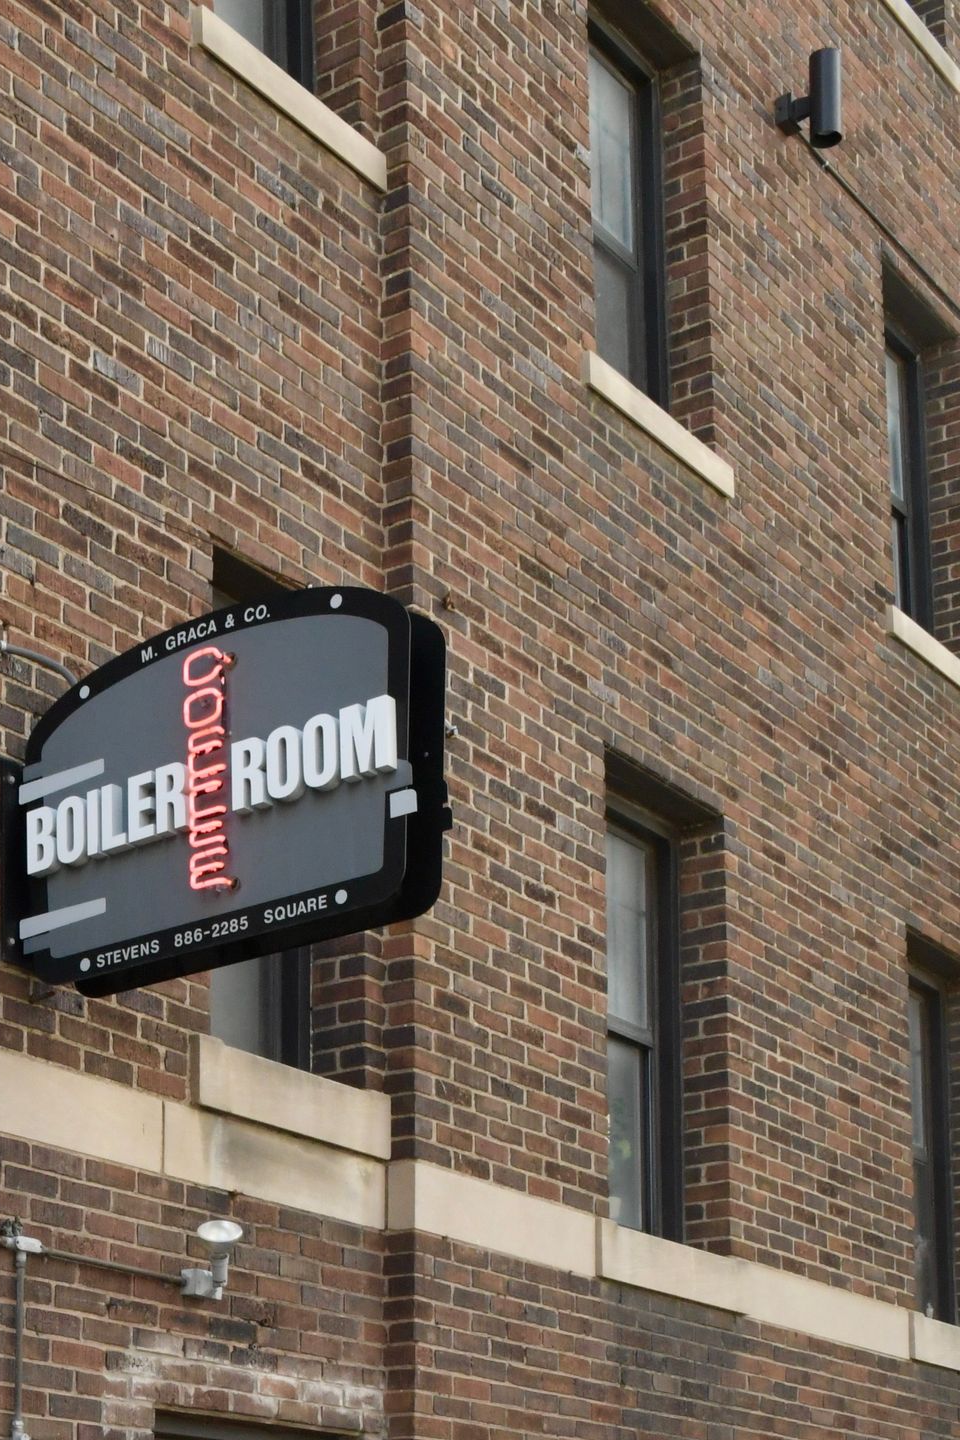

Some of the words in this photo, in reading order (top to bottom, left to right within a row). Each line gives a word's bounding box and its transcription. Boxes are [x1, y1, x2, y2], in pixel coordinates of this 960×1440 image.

[141, 646, 158, 663] M.
[165, 619, 217, 651] GRACA
[224, 613, 235, 629] &
[243, 604, 271, 623] CO.
[26, 761, 191, 877] BOILER
[230, 693, 398, 816] ROOM
[96, 939, 160, 968] STEVENS
[173, 915, 249, 948] 886-2285
[263, 894, 328, 924] SQUARE
